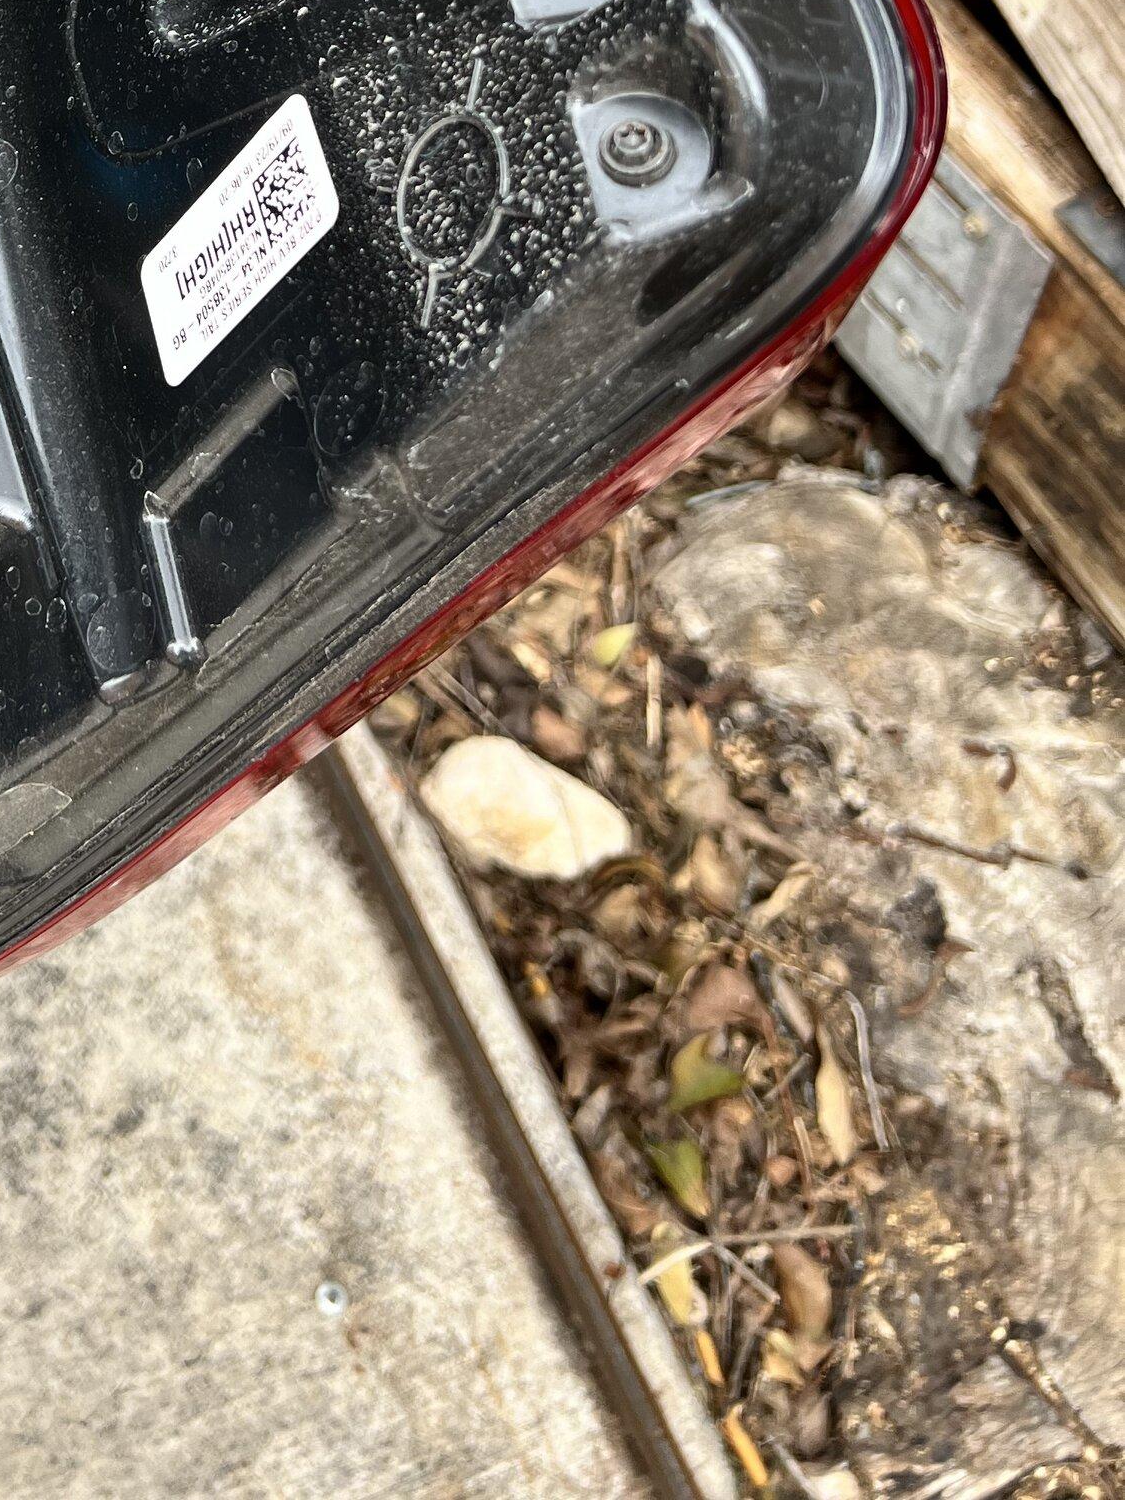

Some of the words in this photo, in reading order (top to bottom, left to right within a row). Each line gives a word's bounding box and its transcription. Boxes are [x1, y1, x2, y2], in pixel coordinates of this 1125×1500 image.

[176, 200, 256, 300] RH[HIGH]
[240, 241, 267, 278] NL34
[277, 233, 296, 261] BEV
[253, 254, 276, 286] HIGH
[195, 280, 230, 326] 13B504
[220, 279, 252, 321] SERIES
[171, 326, 187, 351] BG
[198, 314, 219, 344] TAIL
